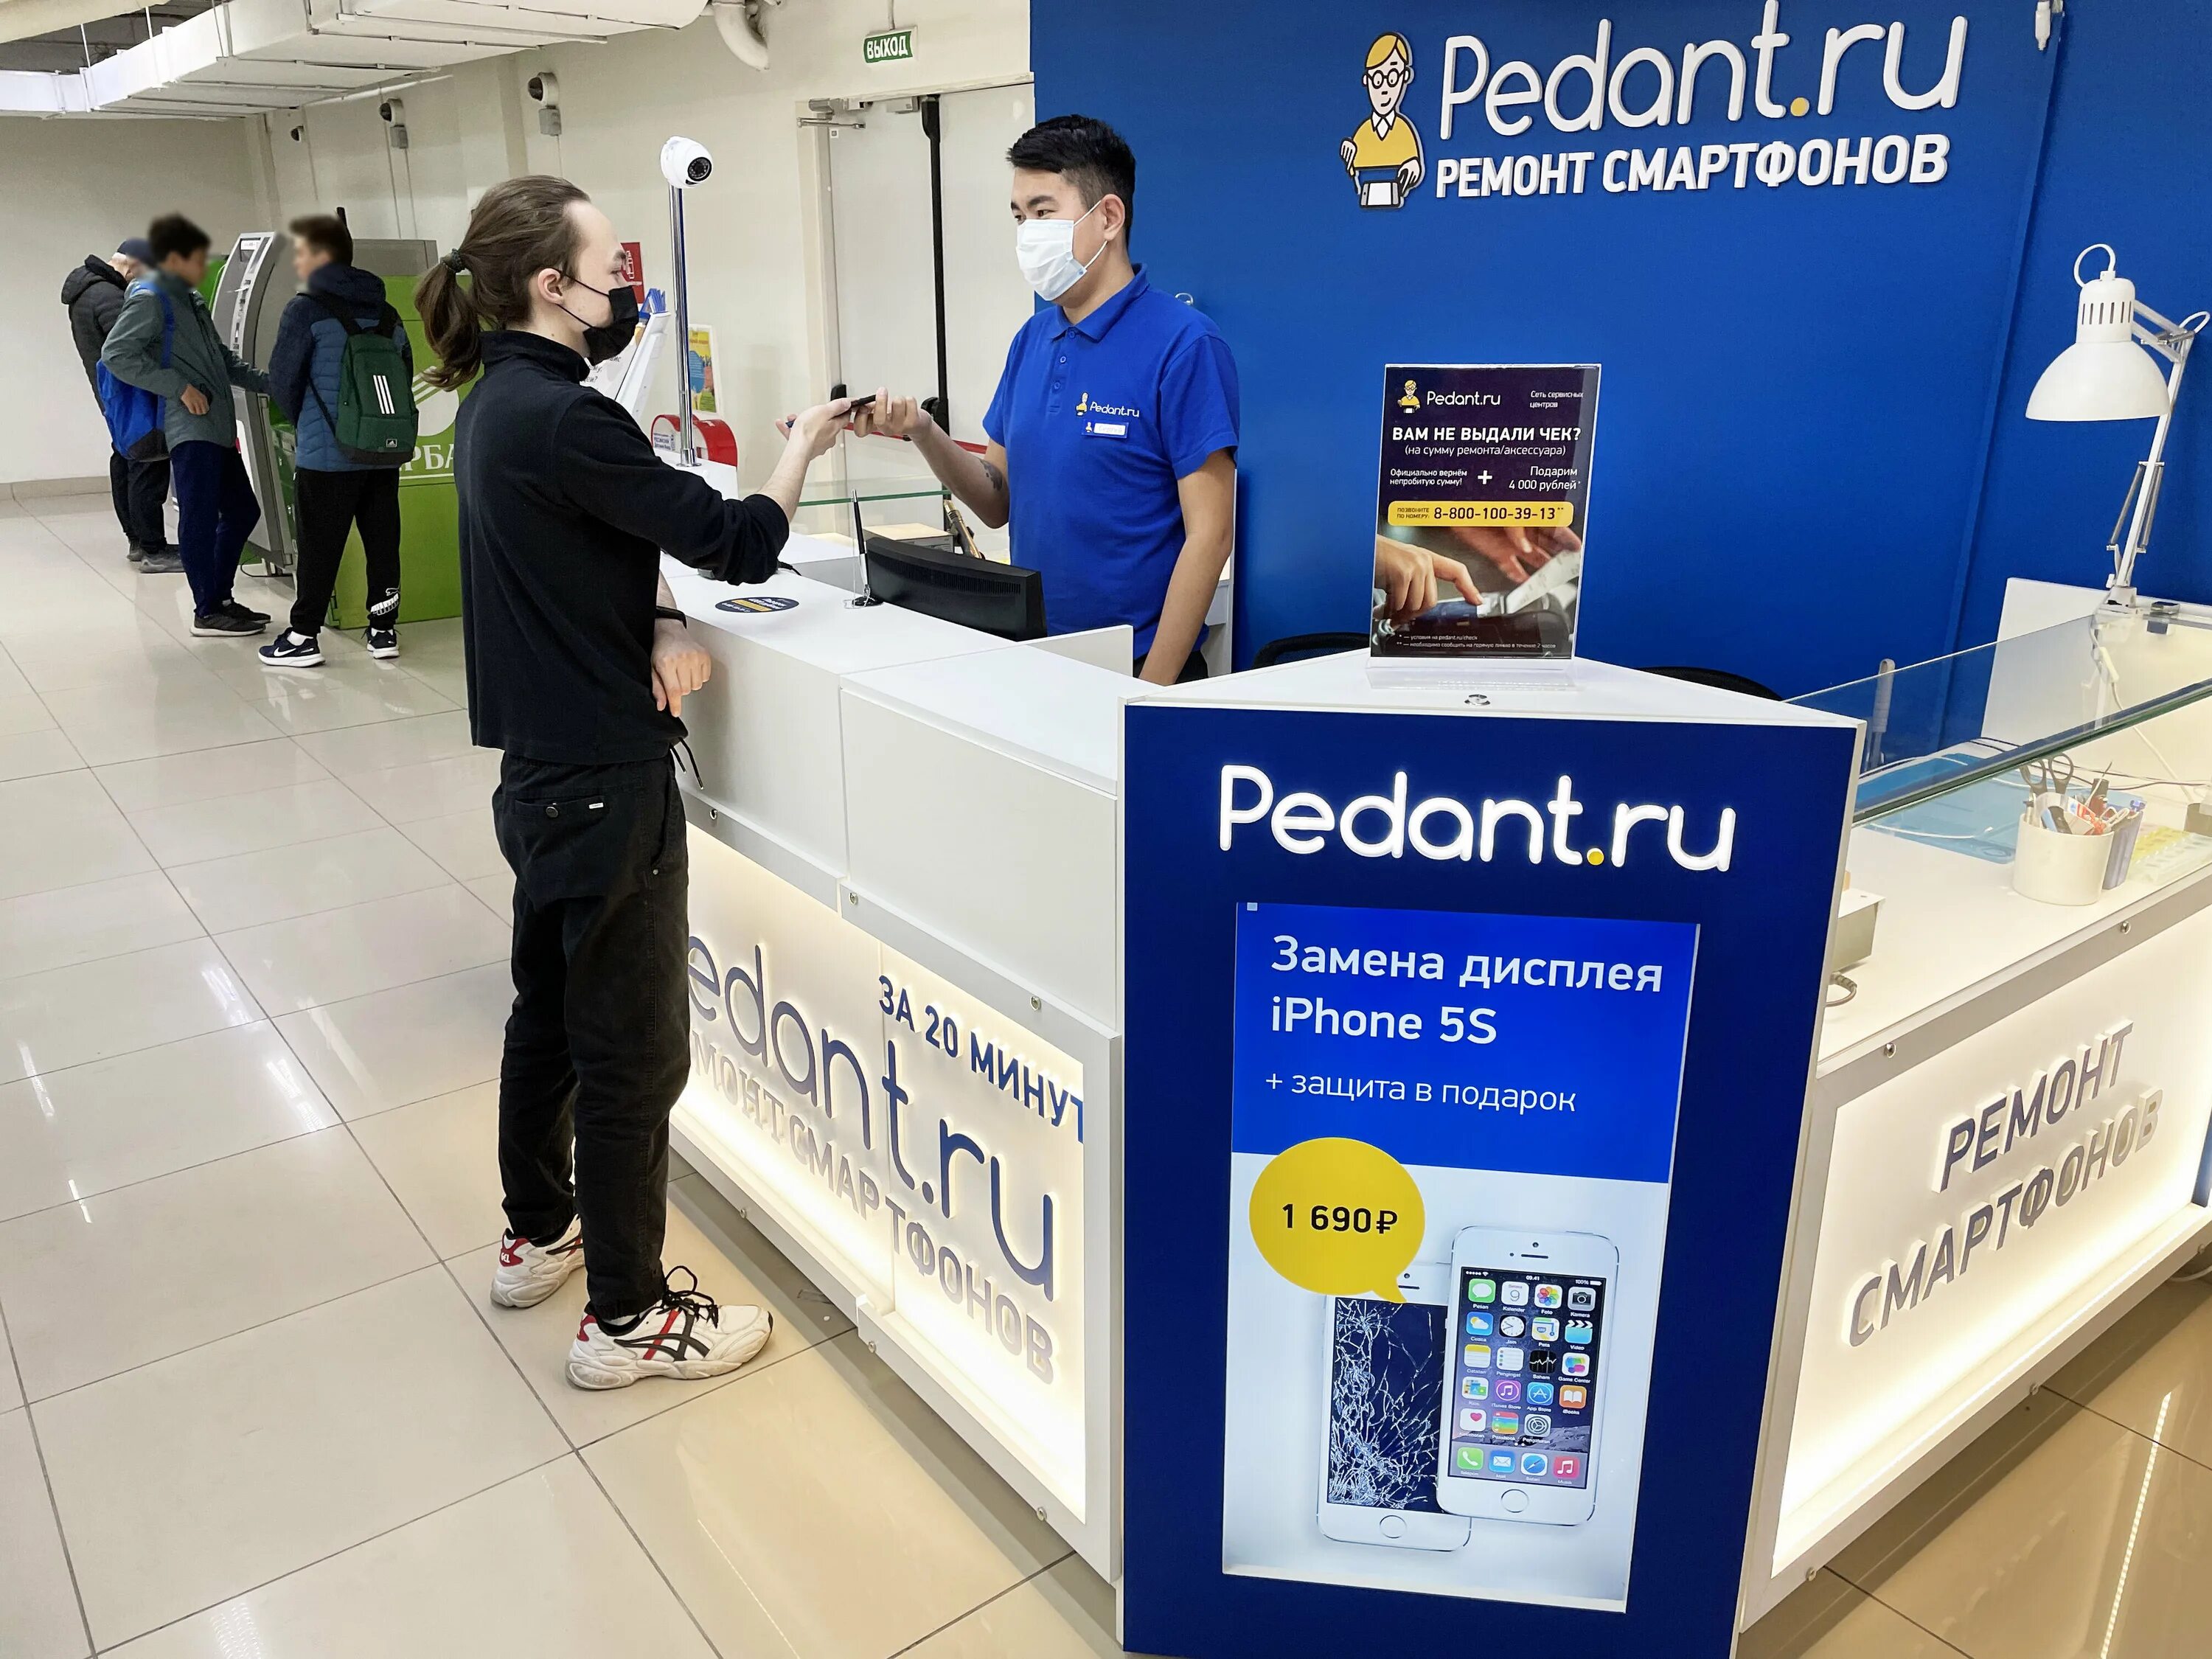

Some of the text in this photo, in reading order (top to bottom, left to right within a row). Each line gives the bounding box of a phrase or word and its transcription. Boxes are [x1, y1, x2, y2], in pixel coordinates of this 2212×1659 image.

[866, 35, 908, 59] ВЫХОД
[1440, 0, 1968, 140] Pedant.ru
[1436, 134, 1951, 198] РЕМОНТ СМАРТФОНОВ
[1090, 401, 1139, 417] Pedant.ru
[1427, 391, 1501, 406] Pedant.ru
[1392, 427, 1582, 443] ВАМ НЕ ВЫДАЛИ ЧЕК?
[1405, 445, 1566, 457] (на сумму ремонта/аксессуара)
[1390, 468, 1467, 477] Официально вернём
[1390, 477, 1462, 487] непробитую сумму!
[1509, 479, 1515, 490] 4
[1517, 479, 1537, 490] 000
[1530, 466, 1578, 478] Подарим
[1219, 765, 1736, 872] Pedant.ru
[1271, 935, 1663, 993] Замена дисплея
[878, 975, 915, 1032] ЗА
[925, 1004, 959, 1057] 20
[1271, 996, 1498, 1044] iPhone 5S
[1291, 1074, 1405, 1102] защита
[1414, 1082, 1432, 1102] в
[1441, 1084, 1576, 1115] подарок
[1933, 1020, 2133, 1193] РЕМОНТ
[688, 935, 1056, 1302] edant.ru
[1281, 1204, 1294, 1228] 1
[1845, 1088, 2163, 1348] СМАРТФОНОВ
[789, 1113, 1056, 1385] СМАРТФОНОВ
